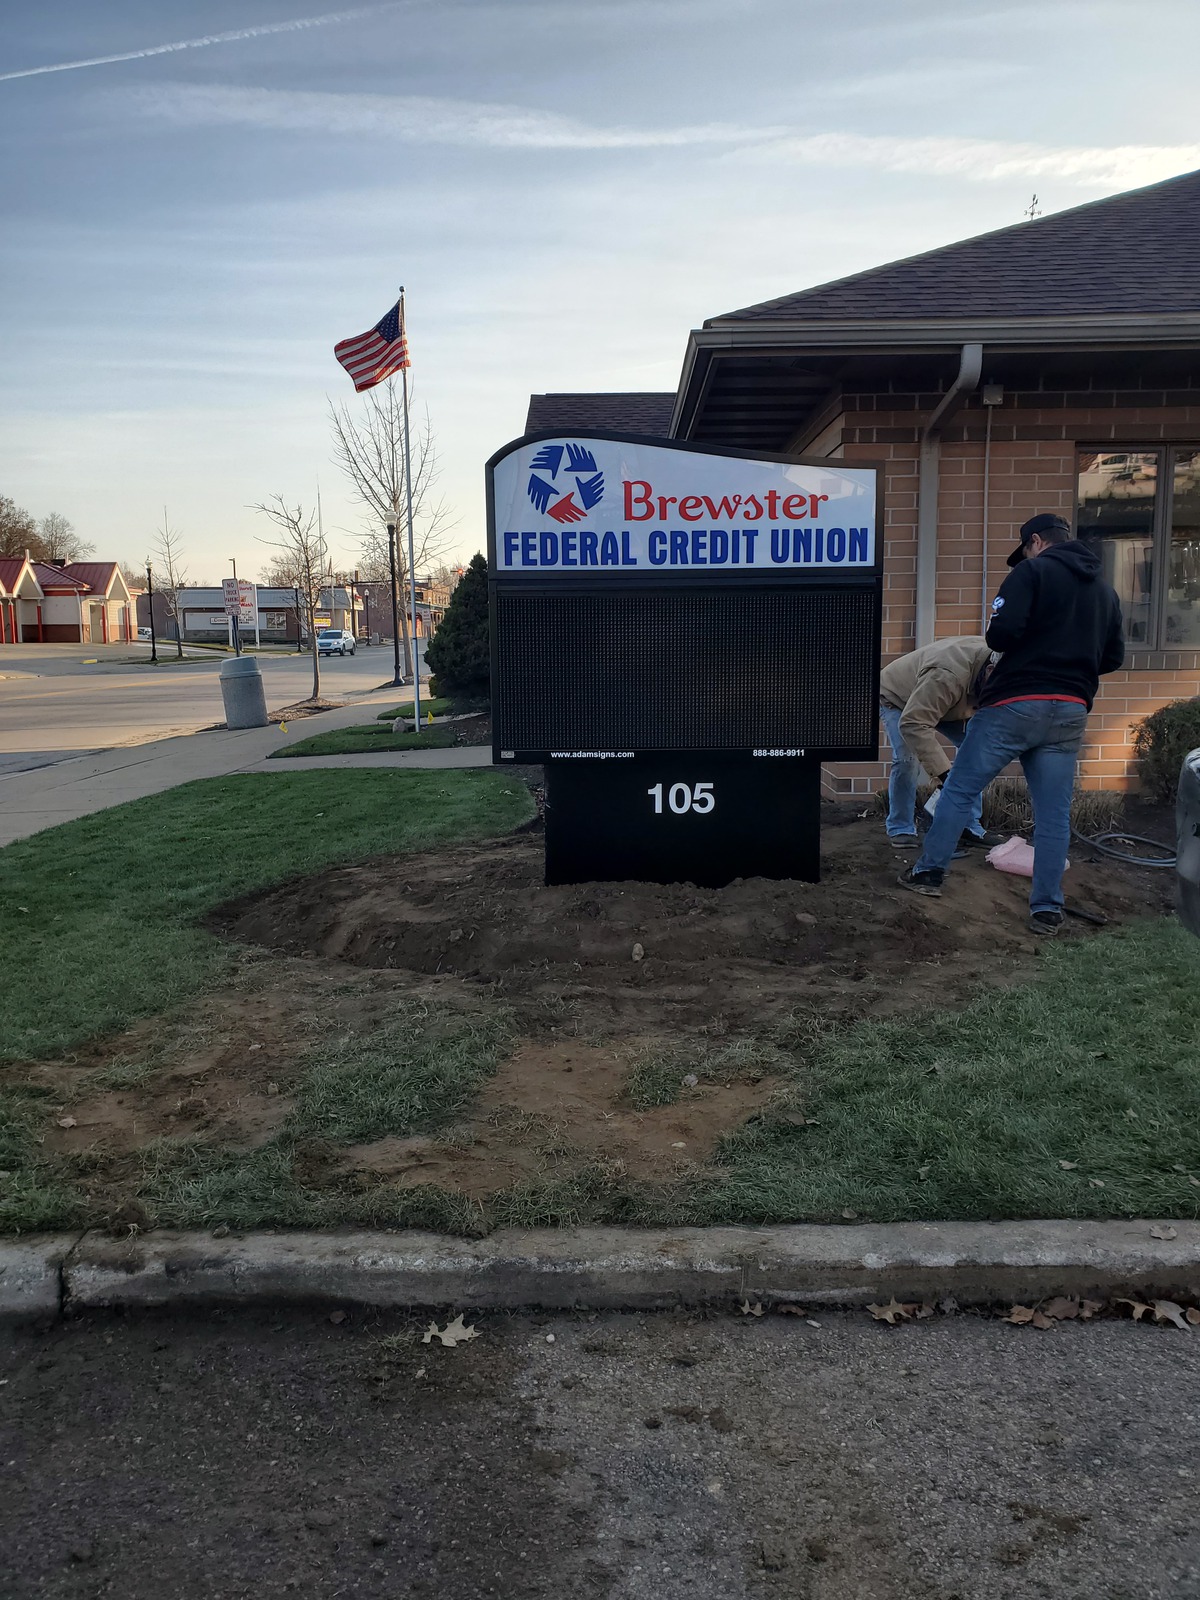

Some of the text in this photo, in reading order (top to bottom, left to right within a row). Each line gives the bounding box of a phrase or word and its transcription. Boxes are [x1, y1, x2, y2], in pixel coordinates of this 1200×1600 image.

[622, 480, 829, 521] Brewster
[503, 527, 869, 567] FEDERAL CREDIT UNION
[550, 750, 635, 760] www.adamsigns.com
[752, 748, 805, 757] 888-886-9911
[647, 782, 716, 815] 105
